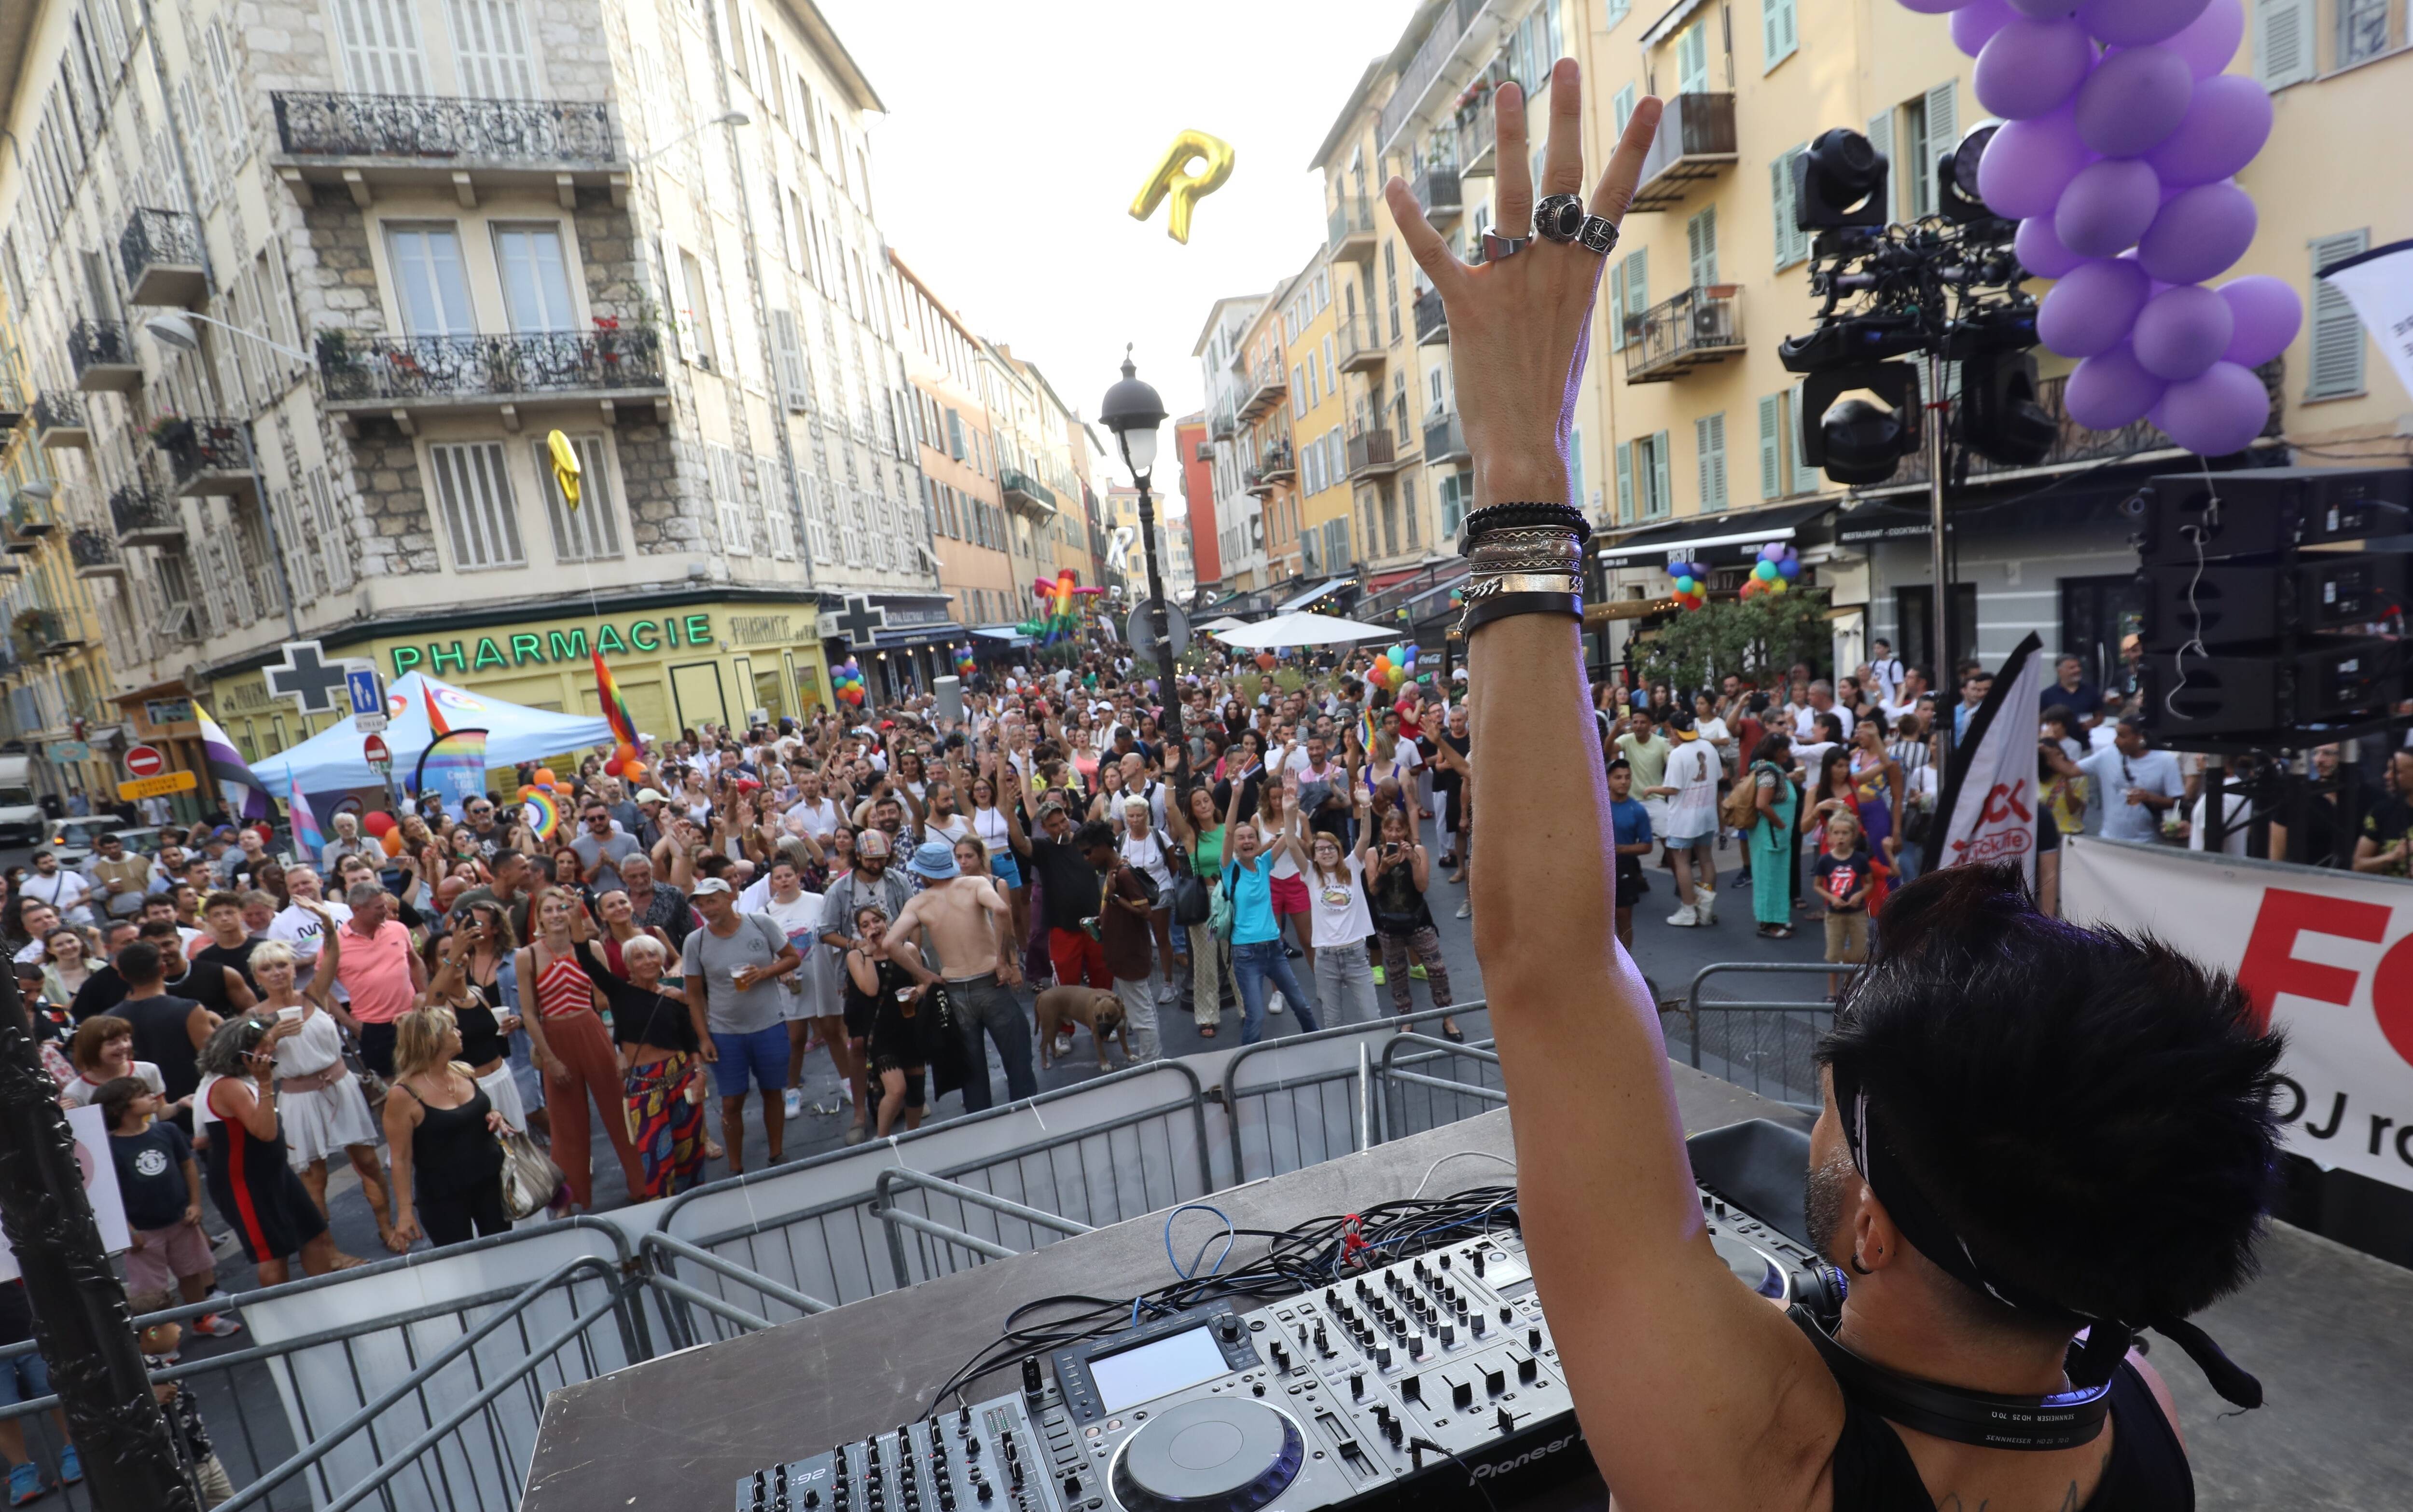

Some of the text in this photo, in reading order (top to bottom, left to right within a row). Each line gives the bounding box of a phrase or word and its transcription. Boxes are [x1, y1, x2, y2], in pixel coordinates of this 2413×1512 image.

[1841, 529, 1883, 541] RESTAURANT
[1888, 525, 1928, 536] COCKTAILS
[391, 614, 714, 676] PHARMACIE
[1418, 653, 1442, 665] Coca-Cola
[2235, 887, 2413, 1069] F
[1985, 1434, 2032, 1444] SENNHEISER
[1469, 1434, 1574, 1487] Pioneer
